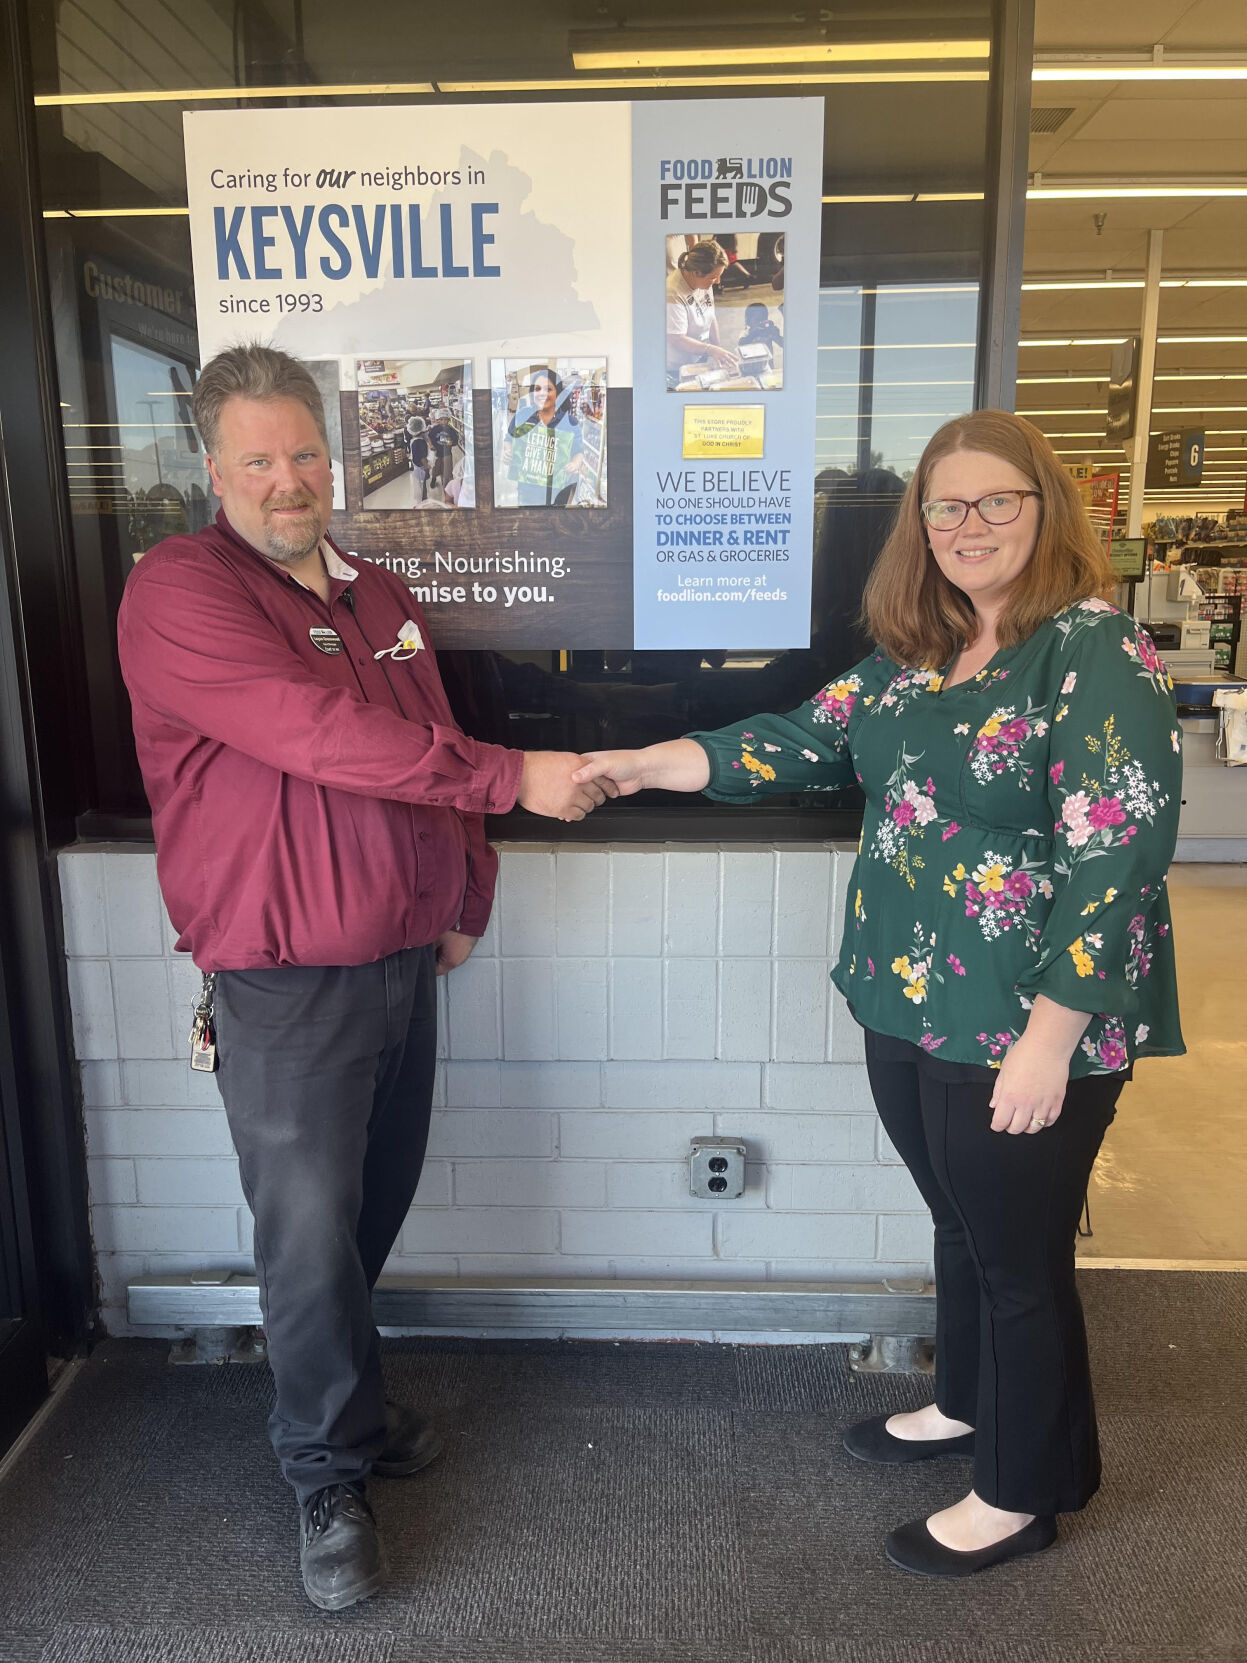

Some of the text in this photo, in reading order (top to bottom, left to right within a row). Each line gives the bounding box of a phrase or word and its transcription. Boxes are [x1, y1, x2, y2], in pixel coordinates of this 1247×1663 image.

[210, 165, 486, 193] Caring for our neighbors in
[660, 157, 793, 181] FOOD LION
[660, 180, 793, 220] FEEDS
[213, 202, 501, 281] KEYSVILLE
[83, 260, 184, 314] Customer
[219, 295, 271, 314] since
[275, 293, 324, 314] 1993
[527, 431, 560, 450] LETTUCE
[525, 446, 540, 458] GIVE
[1190, 444, 1199, 467] 6
[656, 470, 792, 493] WE BELIEVE
[656, 496, 791, 509] NO ONE SHOULD HAVE
[655, 512, 792, 526] TO CHOOSE BETWEEN
[656, 529, 791, 546] DINNER & RENT
[347, 550, 571, 579] ring. Nourishing.
[656, 549, 790, 563] OR GAS & GROCERIES
[677, 574, 767, 587] Learn more at
[471, 581, 498, 603] to
[503, 585, 555, 608] you.
[657, 588, 788, 603] foodlion.com/feeds
